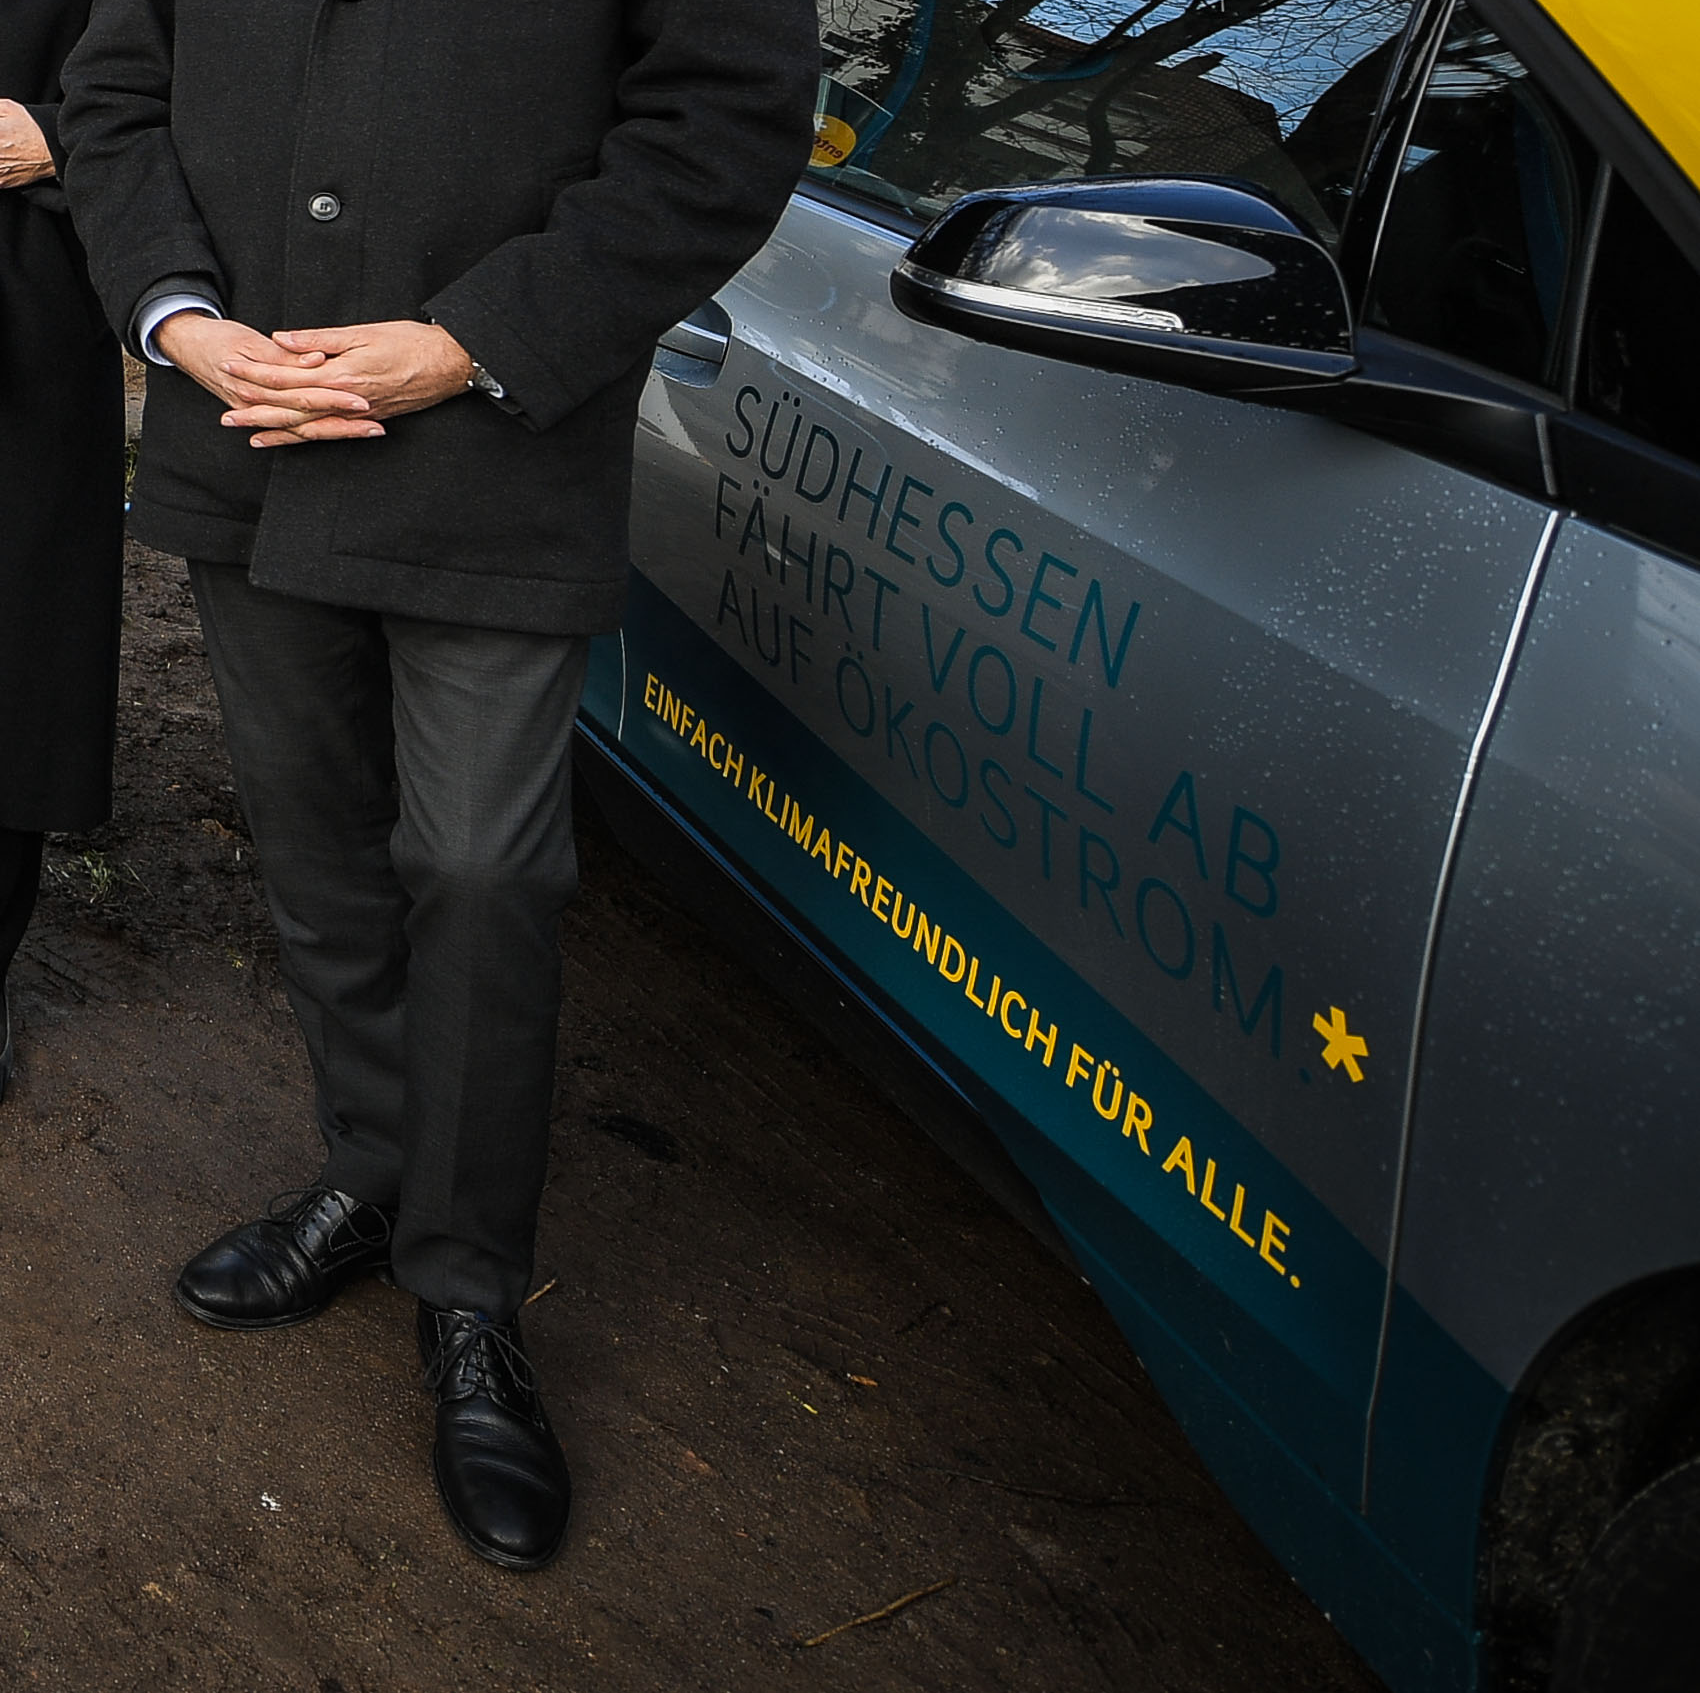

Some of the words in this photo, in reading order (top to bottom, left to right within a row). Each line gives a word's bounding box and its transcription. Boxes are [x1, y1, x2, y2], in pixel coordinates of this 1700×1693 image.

[715, 471, 900, 652] FÄHRT
[921, 602, 1115, 815] VOLL
[1147, 769, 1281, 919] AB
[716, 568, 815, 686] AUF
[725, 385, 1141, 689] SÜDHESSEN
[644, 672, 745, 788] EINFACH
[747, 764, 1058, 1068] KLIMAFREUNDLICH
[1065, 1042, 1153, 1156] FÜR
[1161, 1135, 1301, 1289] ALLE.
